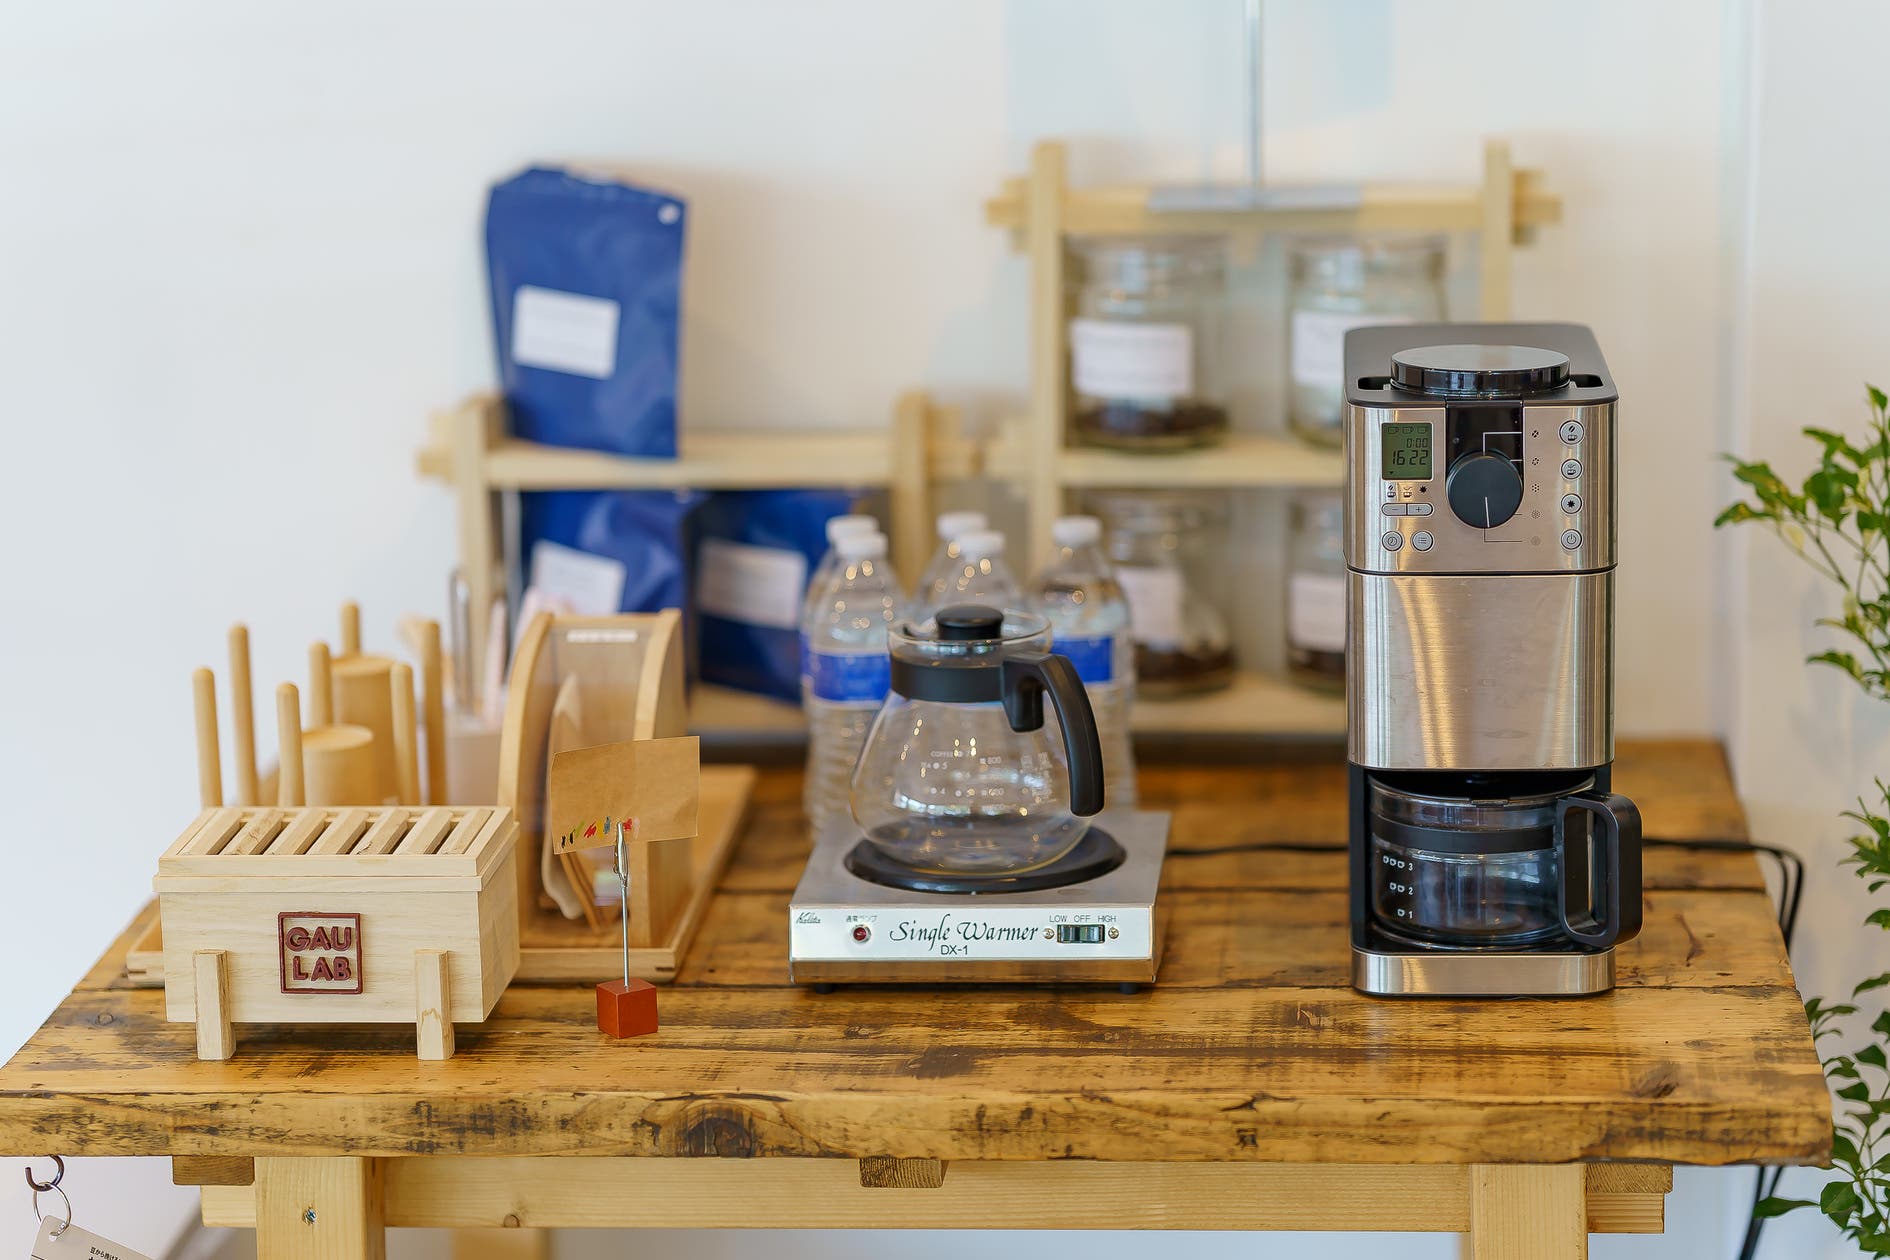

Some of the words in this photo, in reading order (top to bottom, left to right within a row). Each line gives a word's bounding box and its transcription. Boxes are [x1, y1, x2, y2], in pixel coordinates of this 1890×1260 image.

[1406, 437, 1428, 449] 0:00
[1408, 862, 1413, 871] 3
[1408, 886, 1413, 895] 2
[1049, 914, 1068, 923] LOW
[1073, 914, 1091, 923] OFF
[1097, 914, 1117, 923] HIGH
[1408, 910, 1413, 919] 1
[889, 913, 951, 951] Single
[956, 921, 1039, 941] Warmer
[285, 926, 351, 952] GAU
[940, 944, 969, 956] DX-1
[292, 955, 351, 981] LAB
